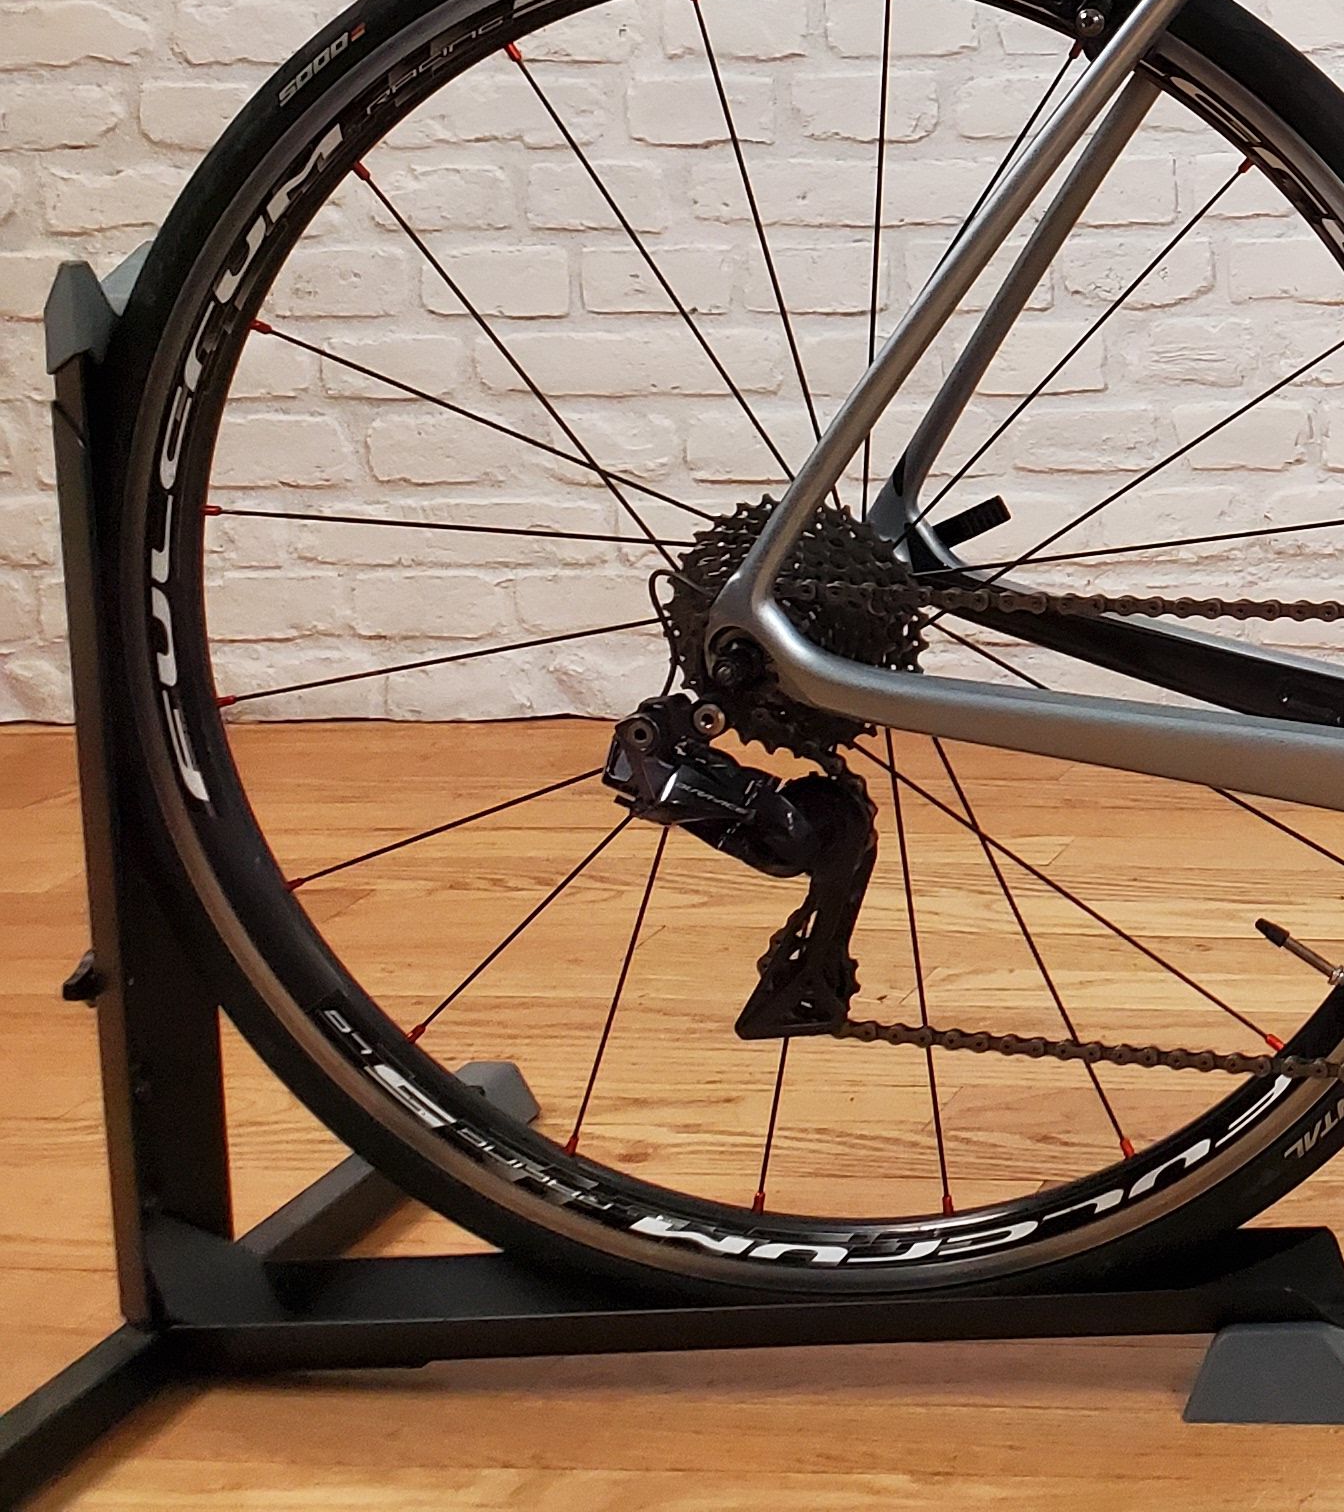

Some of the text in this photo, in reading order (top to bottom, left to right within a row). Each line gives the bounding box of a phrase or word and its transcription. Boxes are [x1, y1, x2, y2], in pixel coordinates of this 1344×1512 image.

[278, 31, 349, 108] 5000
[149, 122, 344, 803] FULCRUM
[628, 1073, 1292, 1267] FULCRUM
